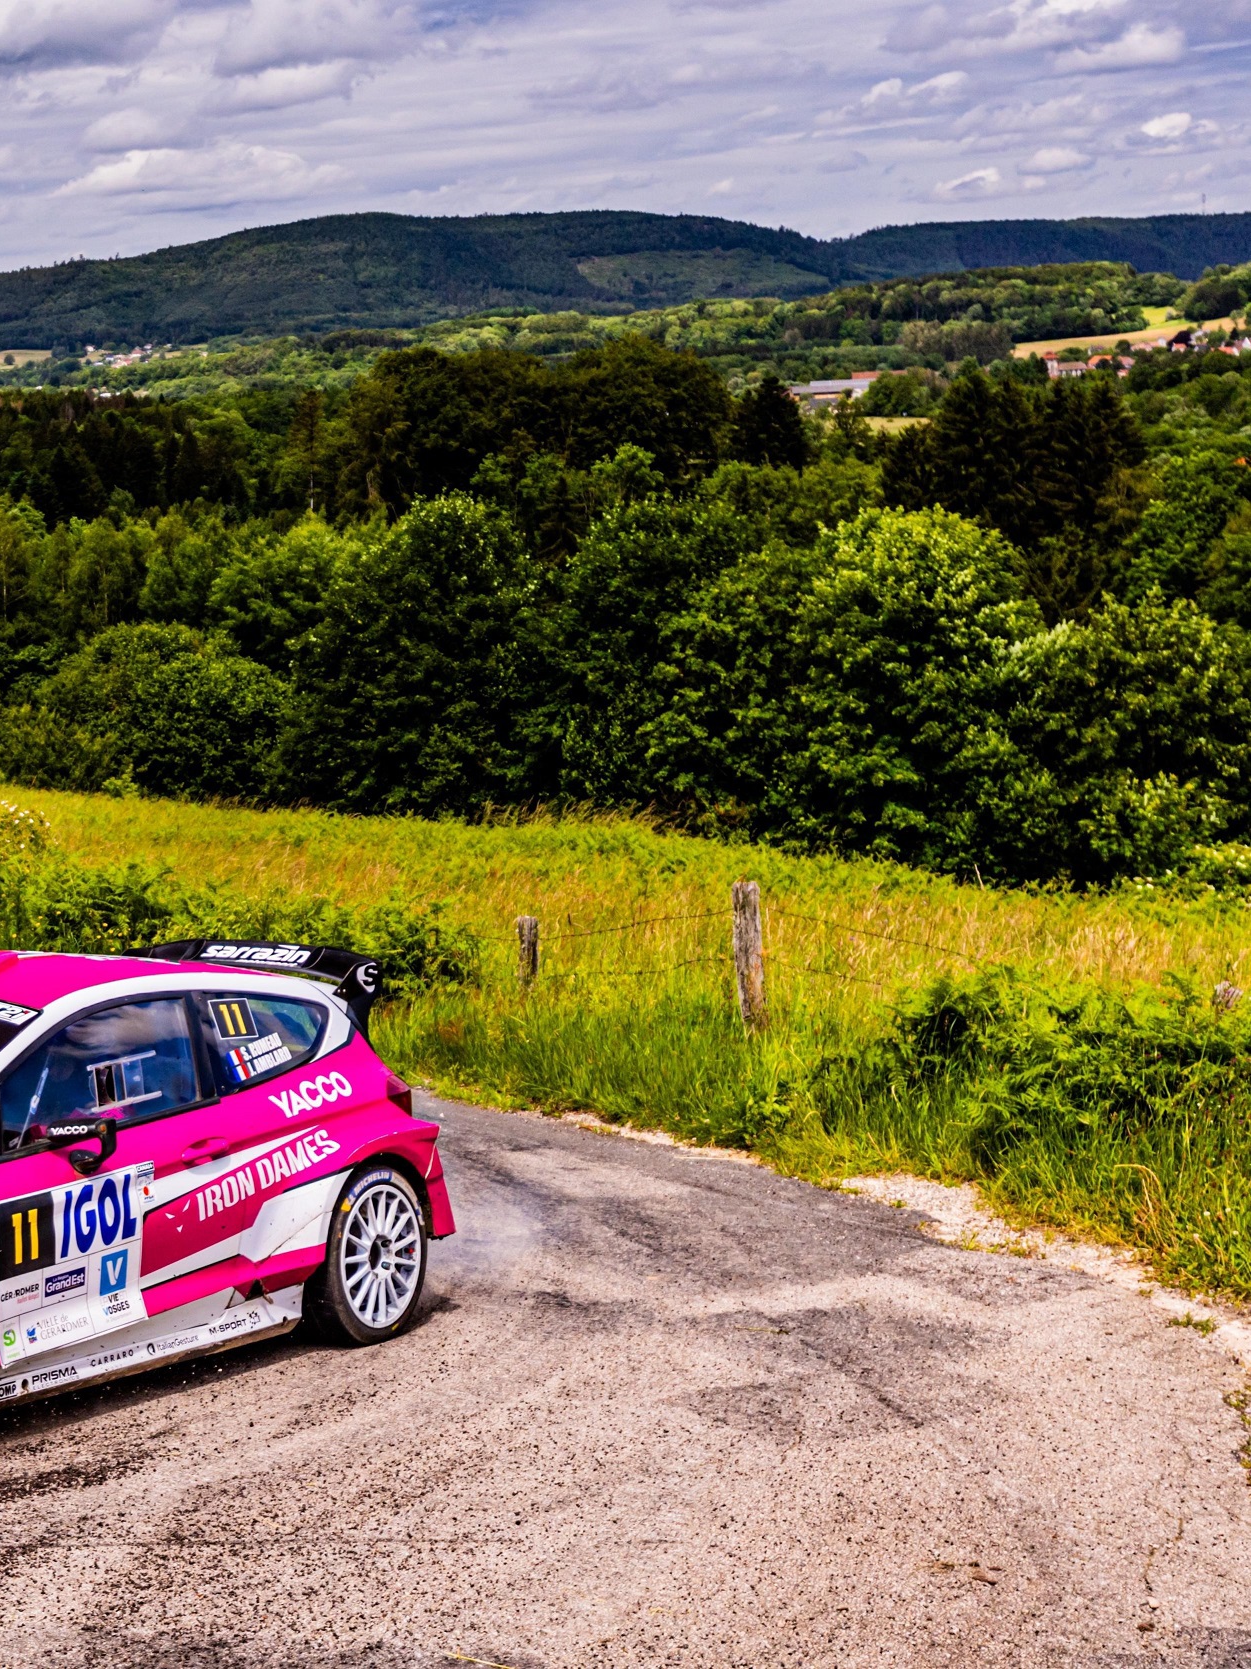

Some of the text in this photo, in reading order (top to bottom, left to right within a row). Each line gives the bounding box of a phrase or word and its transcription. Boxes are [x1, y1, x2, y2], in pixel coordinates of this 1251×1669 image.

[200, 944, 311, 963] sarrazin
[219, 1003, 247, 1036] 11
[253, 1046, 292, 1074] AMBLARD
[268, 1071, 352, 1118] YACCO
[50, 1125, 88, 1136] YACCO
[196, 1129, 341, 1221] IRON DAMES
[353, 1171, 390, 1196] MICHELIN
[60, 1174, 137, 1259] IGOL
[11, 1208, 39, 1265] 11
[45, 1273, 84, 1293] Grand Est
[103, 1300, 131, 1316] VOSGES
[208, 1318, 247, 1336] M-SPORT
[90, 1349, 134, 1367] CARRARO
[31, 1365, 78, 1385] PRISMA
